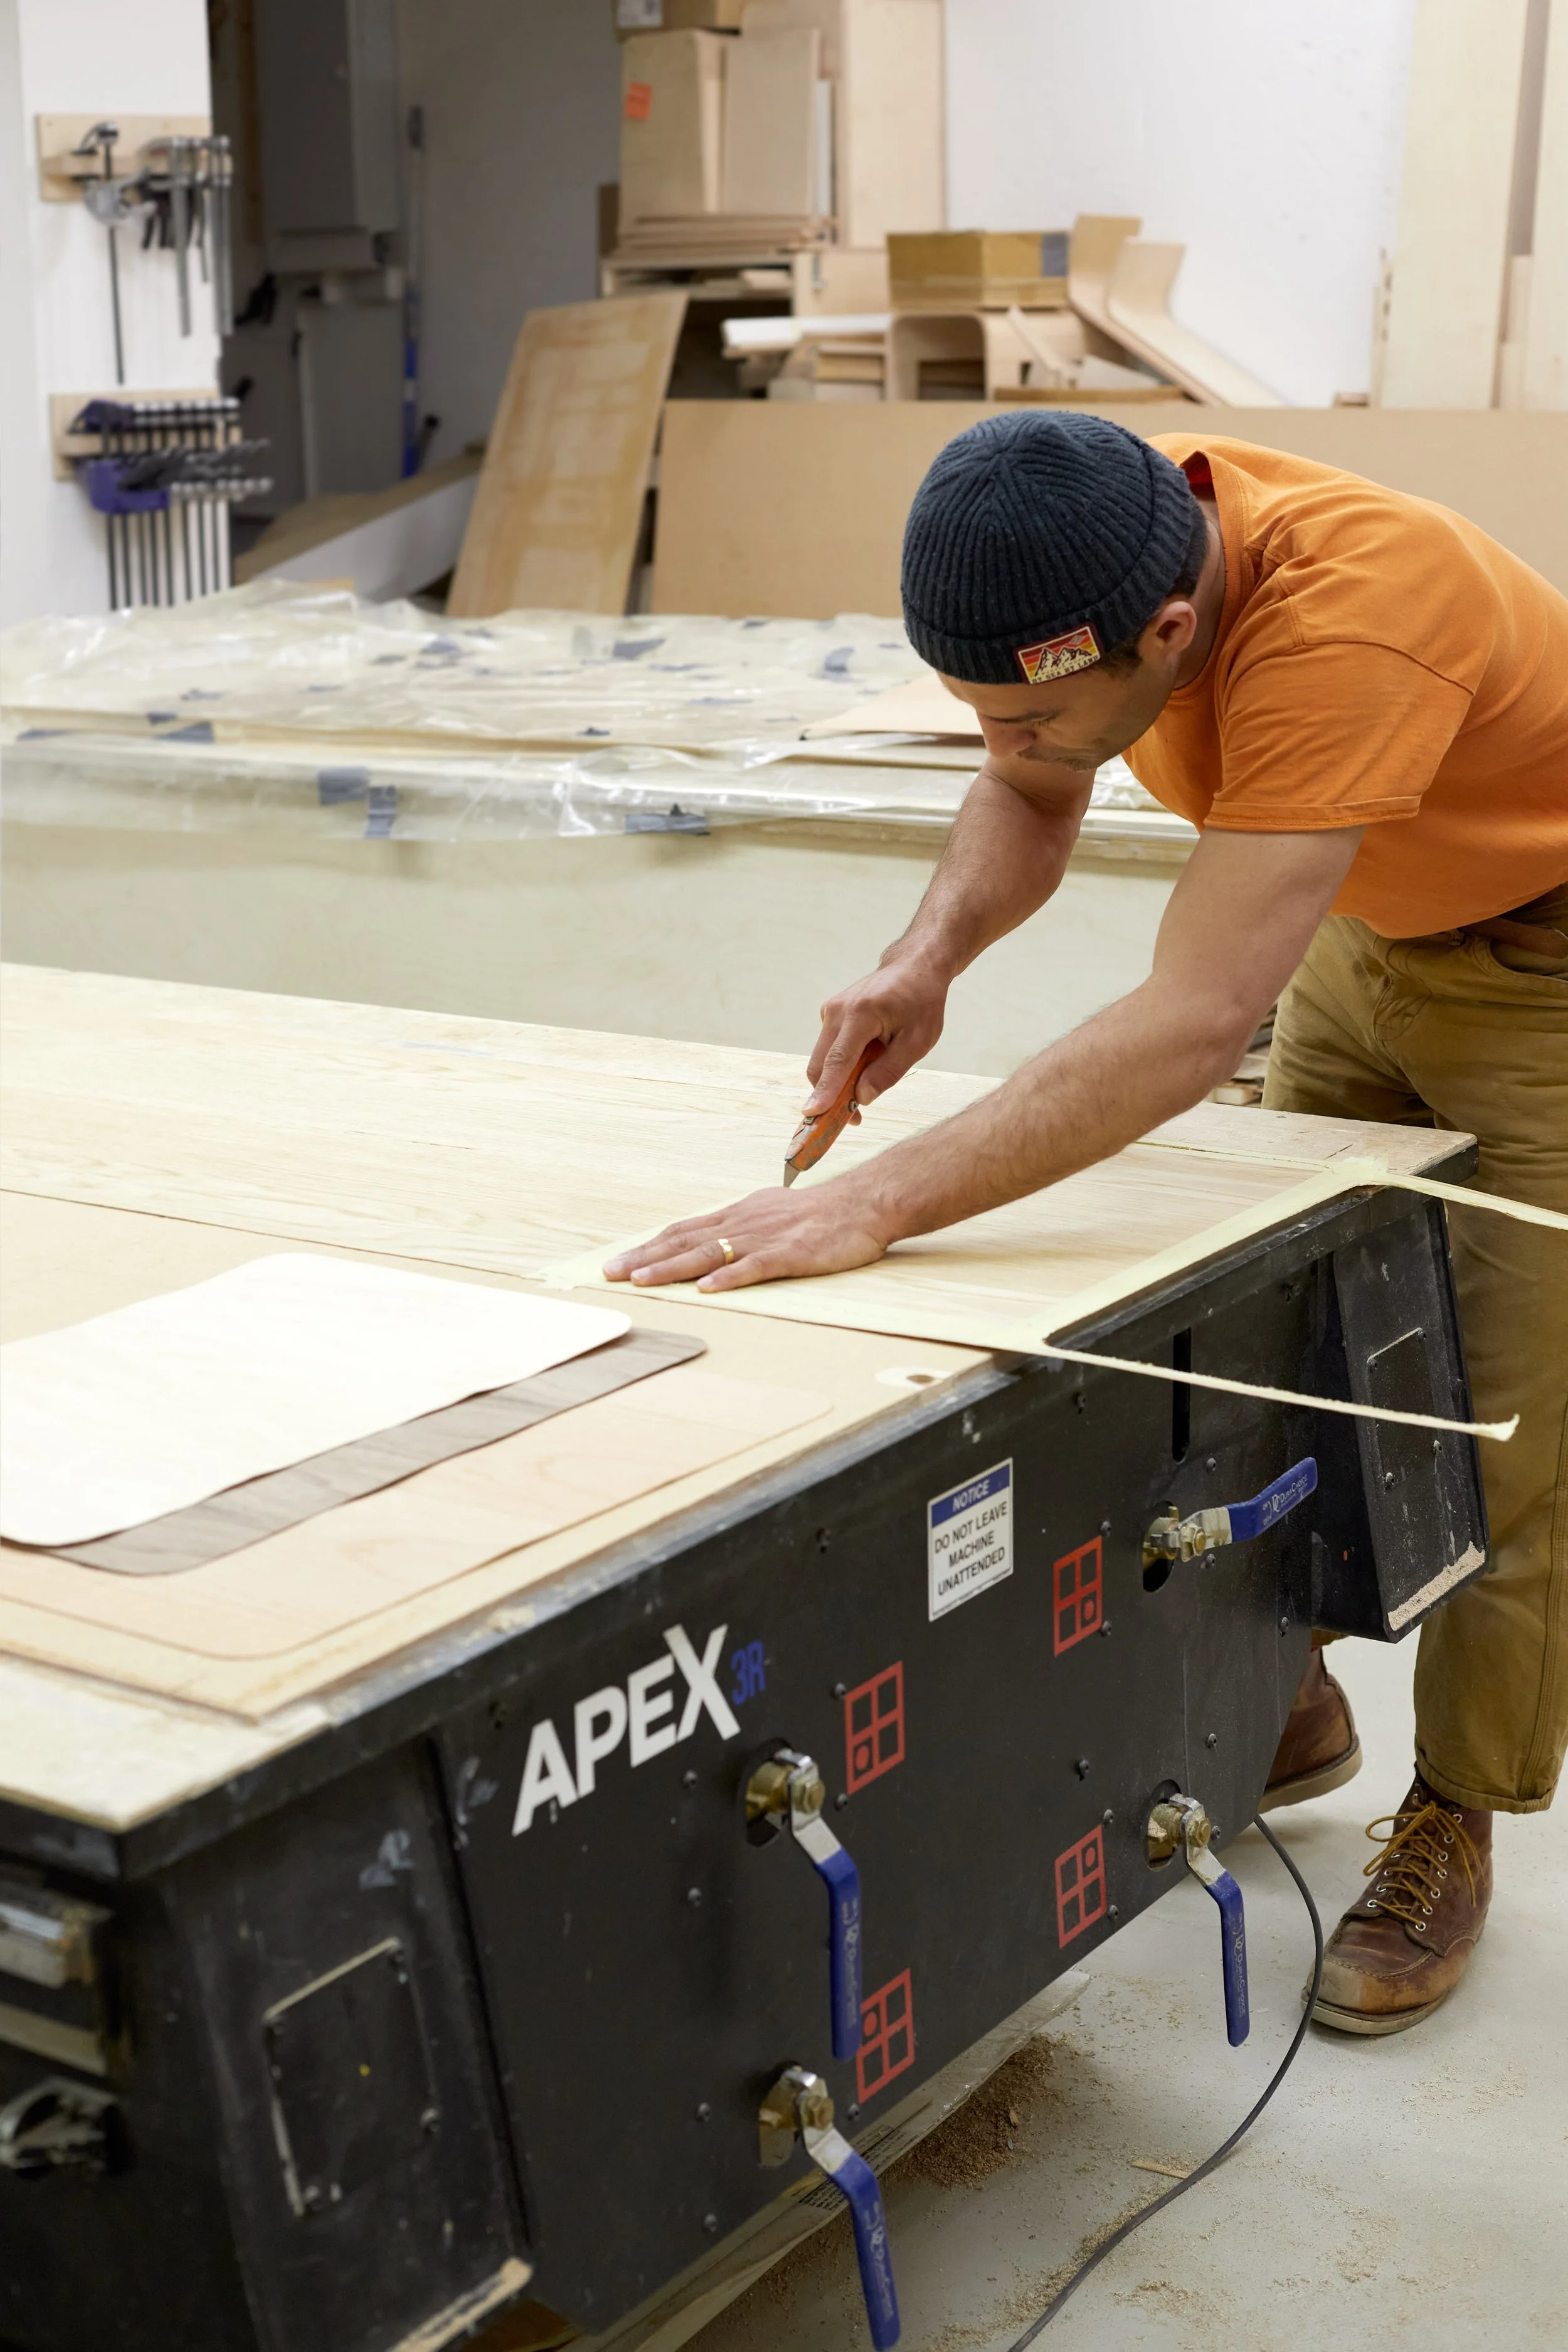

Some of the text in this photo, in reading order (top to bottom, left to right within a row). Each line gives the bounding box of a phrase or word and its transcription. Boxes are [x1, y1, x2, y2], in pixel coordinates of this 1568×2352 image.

[1046, 670, 1061, 679] SEA
[1078, 654, 1098, 669] LAND
[952, 1479, 990, 1512] NOTICE
[935, 1501, 1007, 1554] DO NOT LEAVE
[948, 1530, 994, 1567] MACHINE
[938, 1547, 1005, 1595] UNATTENDED
[512, 1623, 765, 1837] APEX 3R
